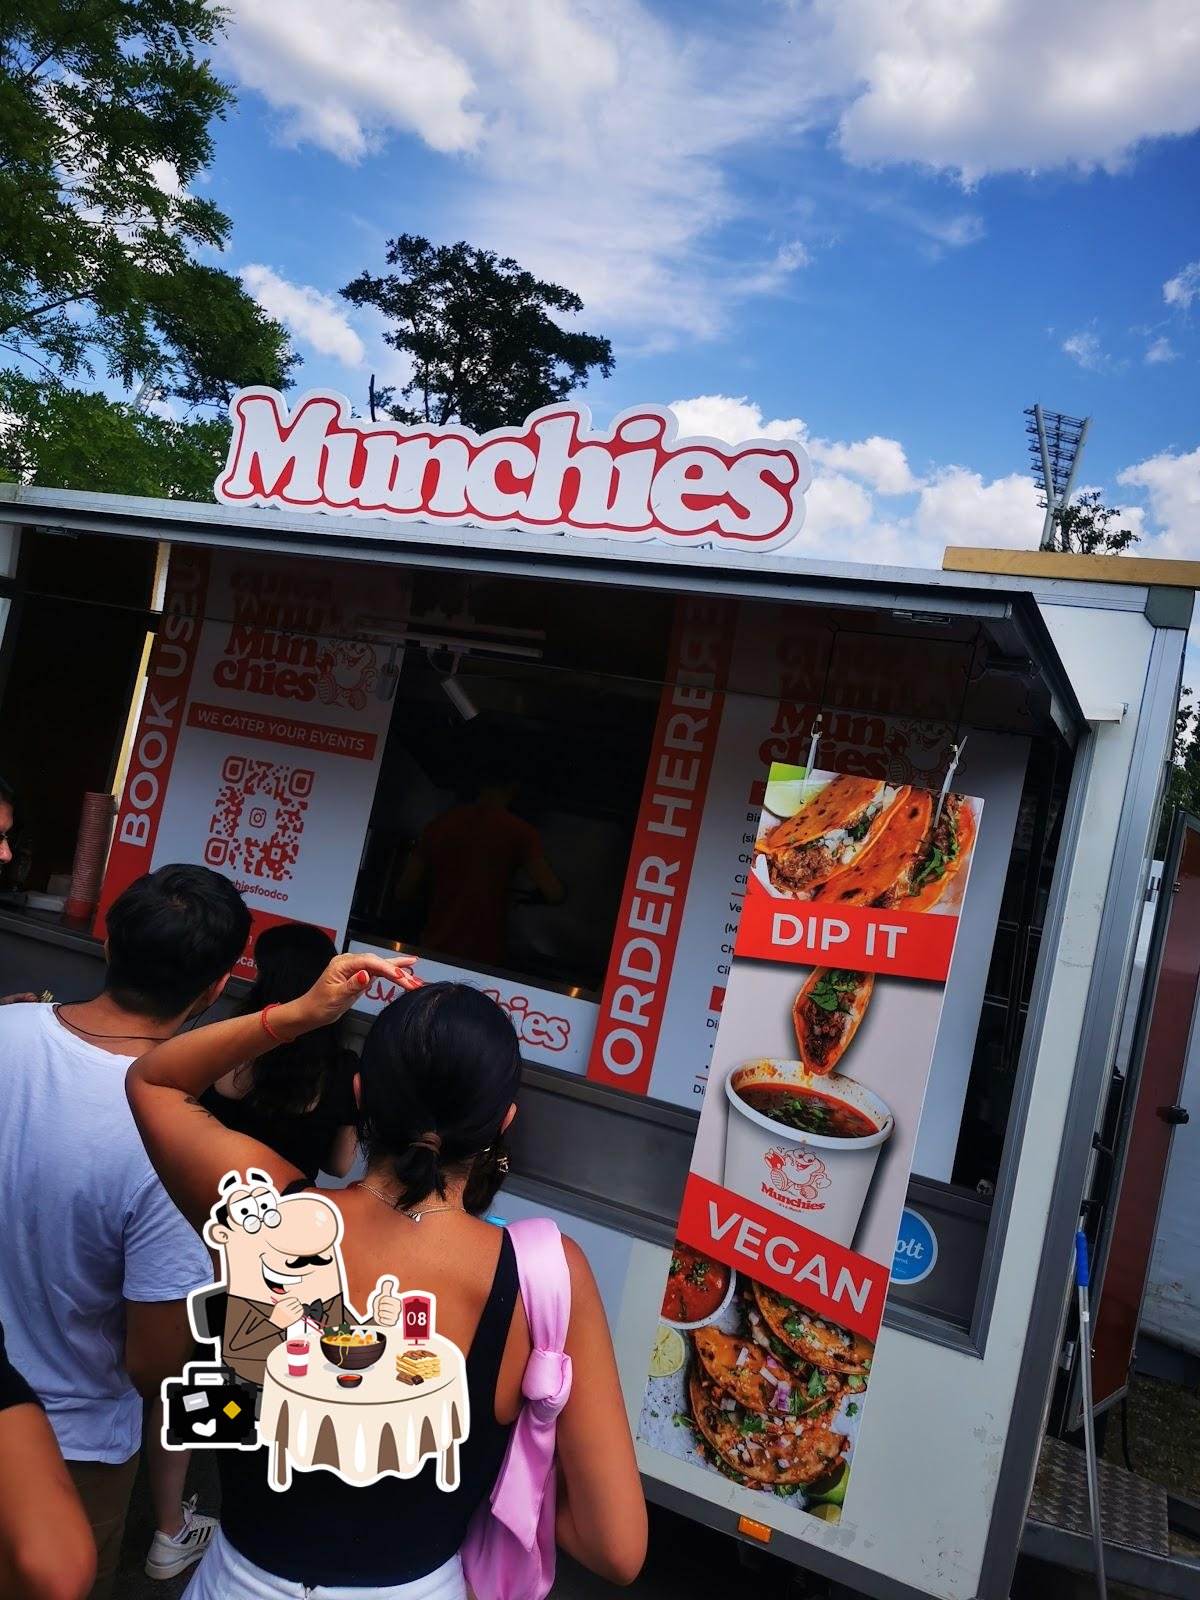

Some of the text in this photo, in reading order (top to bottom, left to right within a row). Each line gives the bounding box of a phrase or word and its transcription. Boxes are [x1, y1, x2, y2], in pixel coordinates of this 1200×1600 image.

[222, 394, 797, 541] Munchies
[224, 623, 318, 667] Mun
[213, 657, 319, 702] chies
[119, 615, 195, 847] BOOK US
[198, 710, 366, 751] WE CATER YOUR EVENTS
[603, 682, 715, 1075] ORDER HERE
[772, 912, 908, 959] DIP IT
[761, 1182, 826, 1210] Munchies
[709, 1200, 873, 1314] VEGAN
